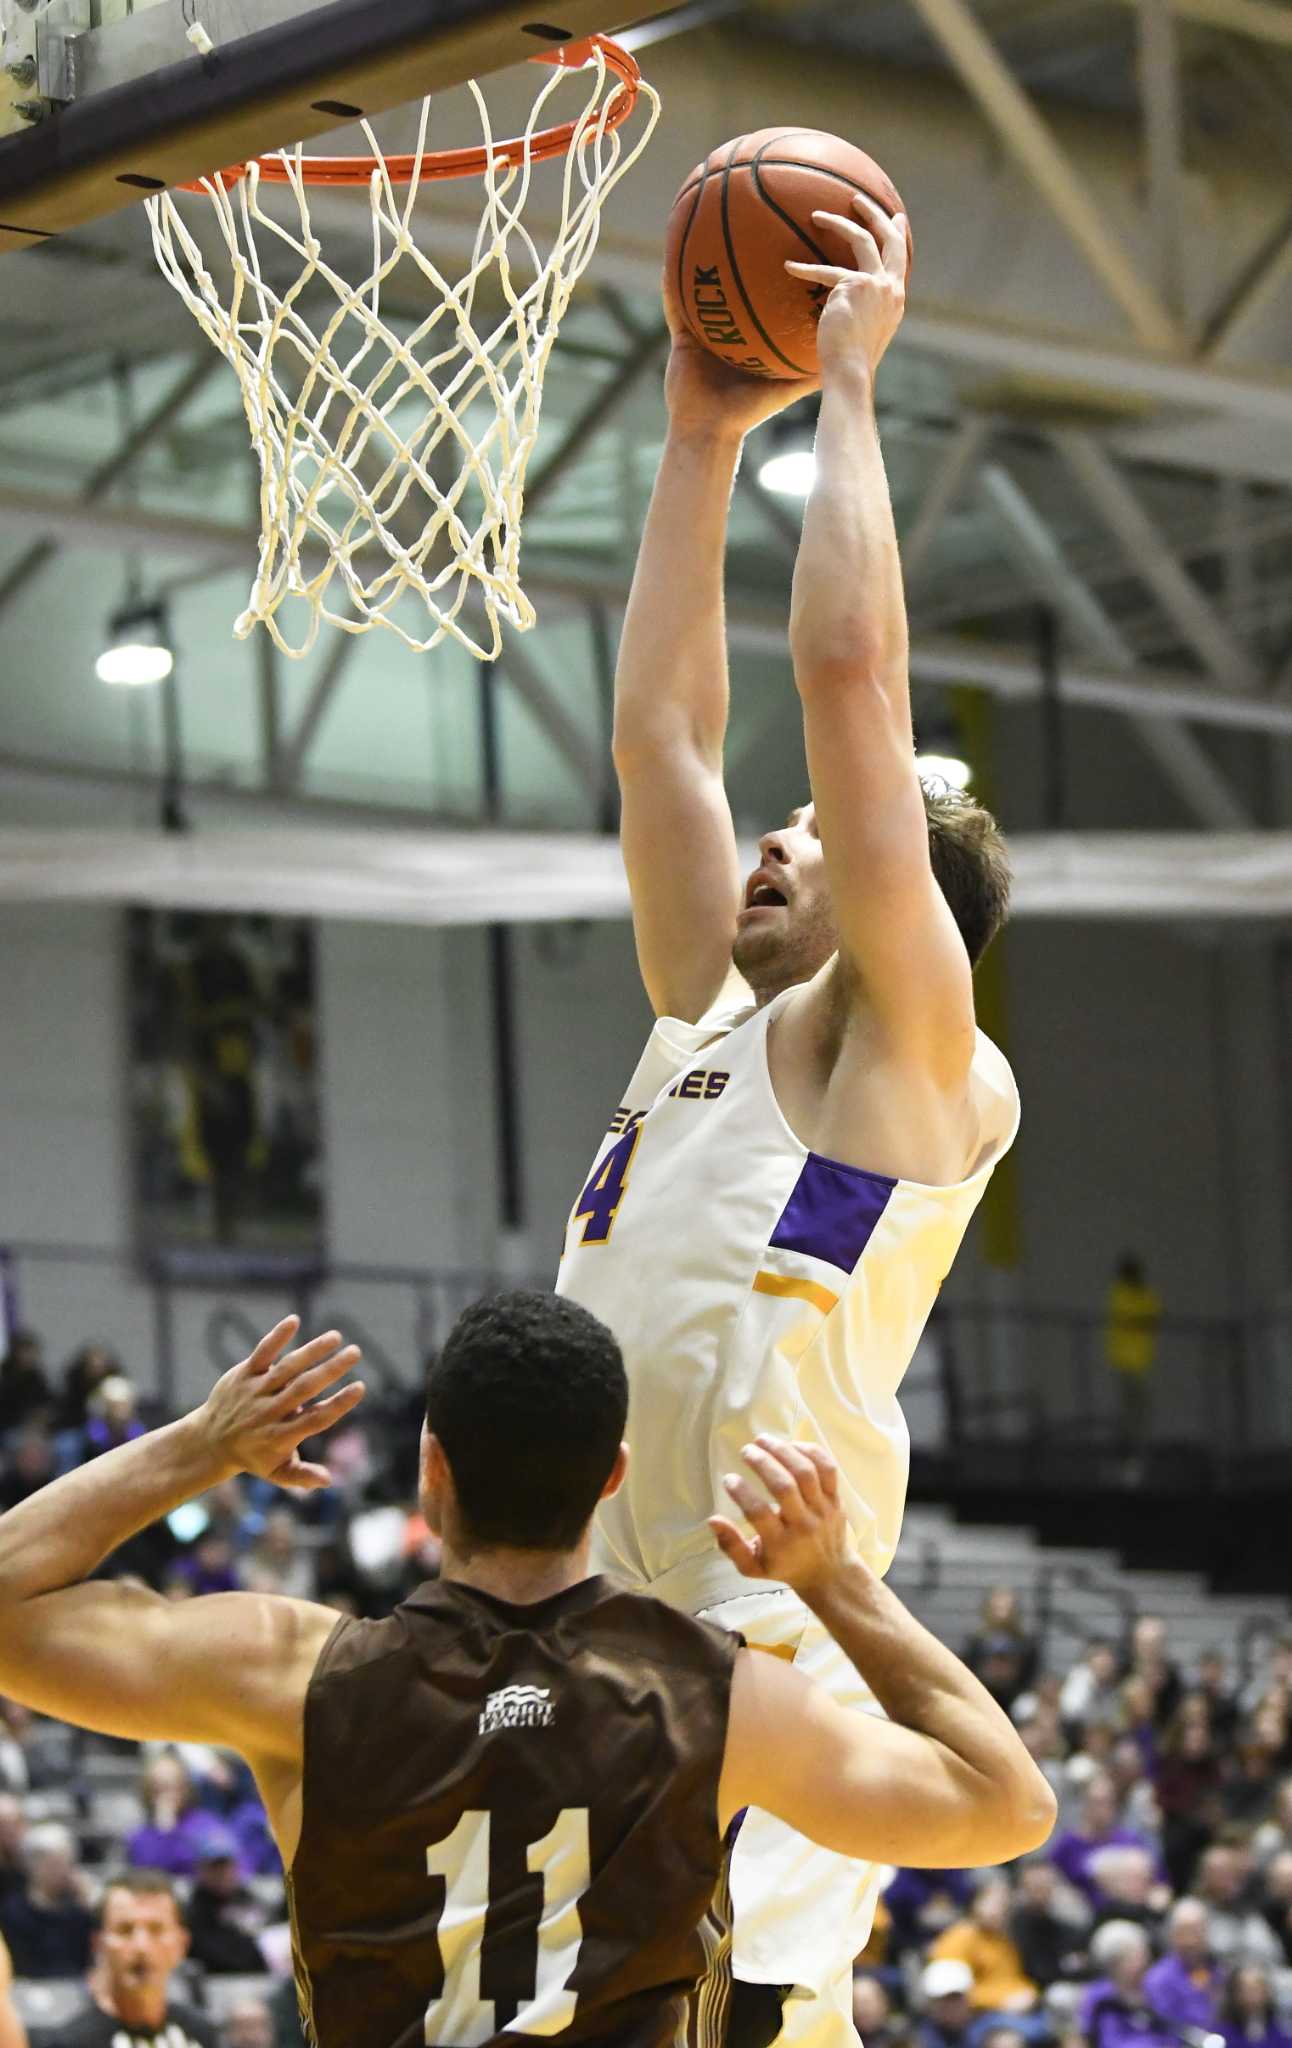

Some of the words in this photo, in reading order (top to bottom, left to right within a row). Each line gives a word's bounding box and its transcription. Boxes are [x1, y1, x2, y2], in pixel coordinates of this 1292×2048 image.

[694, 265, 748, 345] ROCK
[562, 1119, 645, 1250] 4
[424, 1807, 591, 2047] 11
